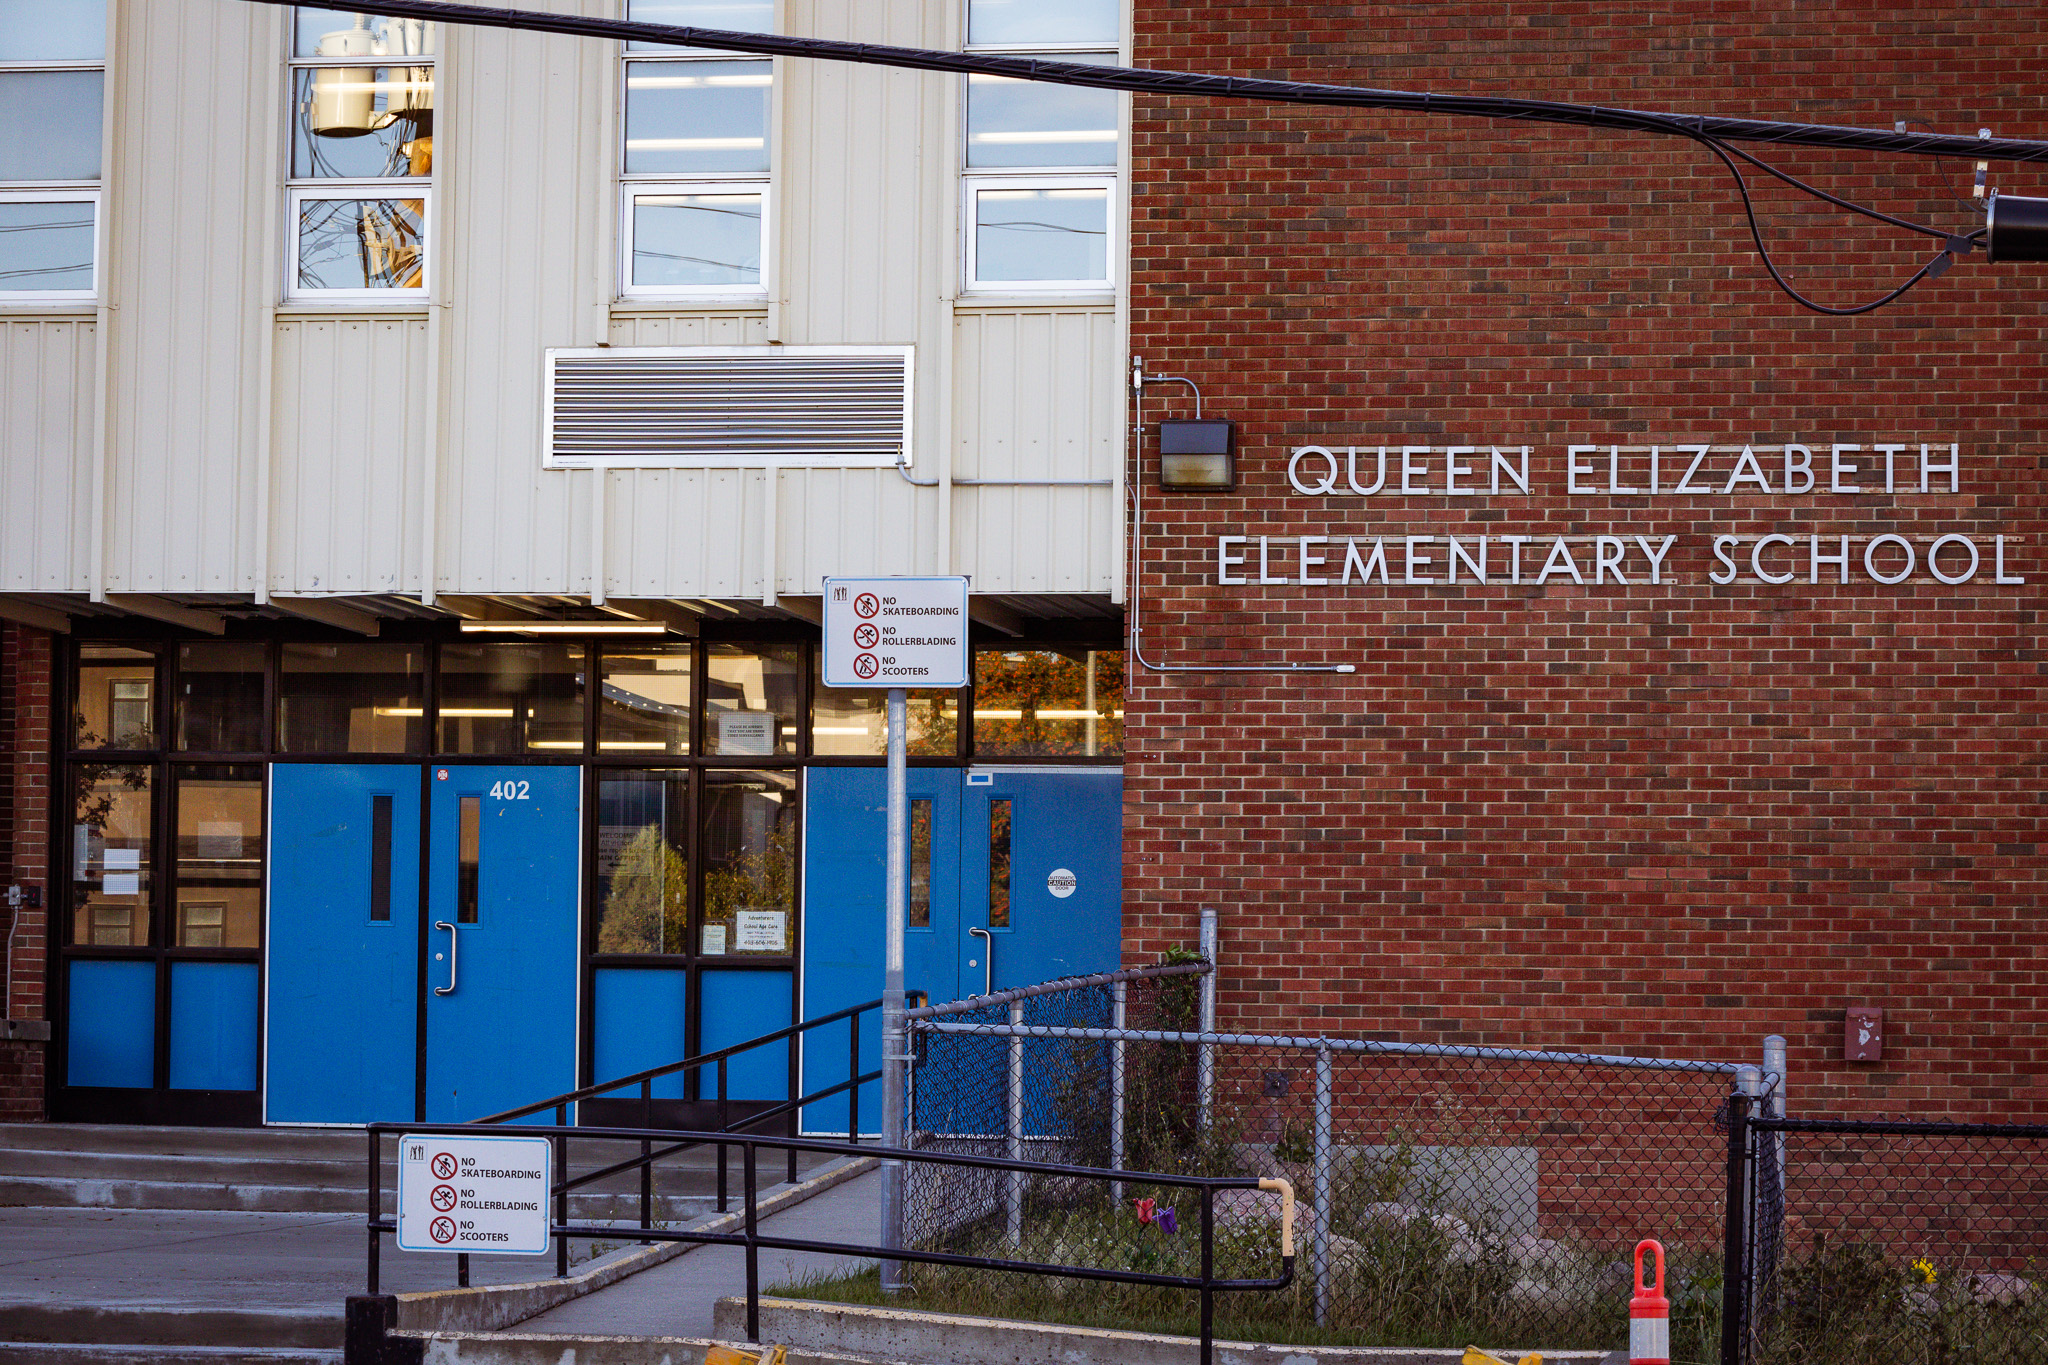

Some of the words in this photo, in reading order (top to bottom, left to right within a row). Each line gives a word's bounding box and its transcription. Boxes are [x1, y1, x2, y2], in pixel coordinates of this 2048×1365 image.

[1288, 444, 1530, 496] QUEEN
[1567, 443, 1960, 496] ELIZABETH
[1218, 534, 1676, 587] ELEMENTARY
[1709, 533, 2025, 586] SCHOOL
[882, 597, 897, 605] NO
[882, 607, 959, 616] SKATEBOARDING
[882, 627, 896, 635] NO
[882, 637, 957, 646] ROLLERBLADING
[882, 656, 896, 665] NO
[882, 667, 929, 676] SCOOTERS
[489, 780, 530, 801] 402
[461, 1157, 476, 1167] NO
[461, 1168, 541, 1180] SKATEBOARDING
[460, 1189, 475, 1198] NO
[460, 1200, 538, 1211] ROLLERBLADING
[460, 1221, 475, 1229] NO
[460, 1232, 509, 1242] SCOOTERS
